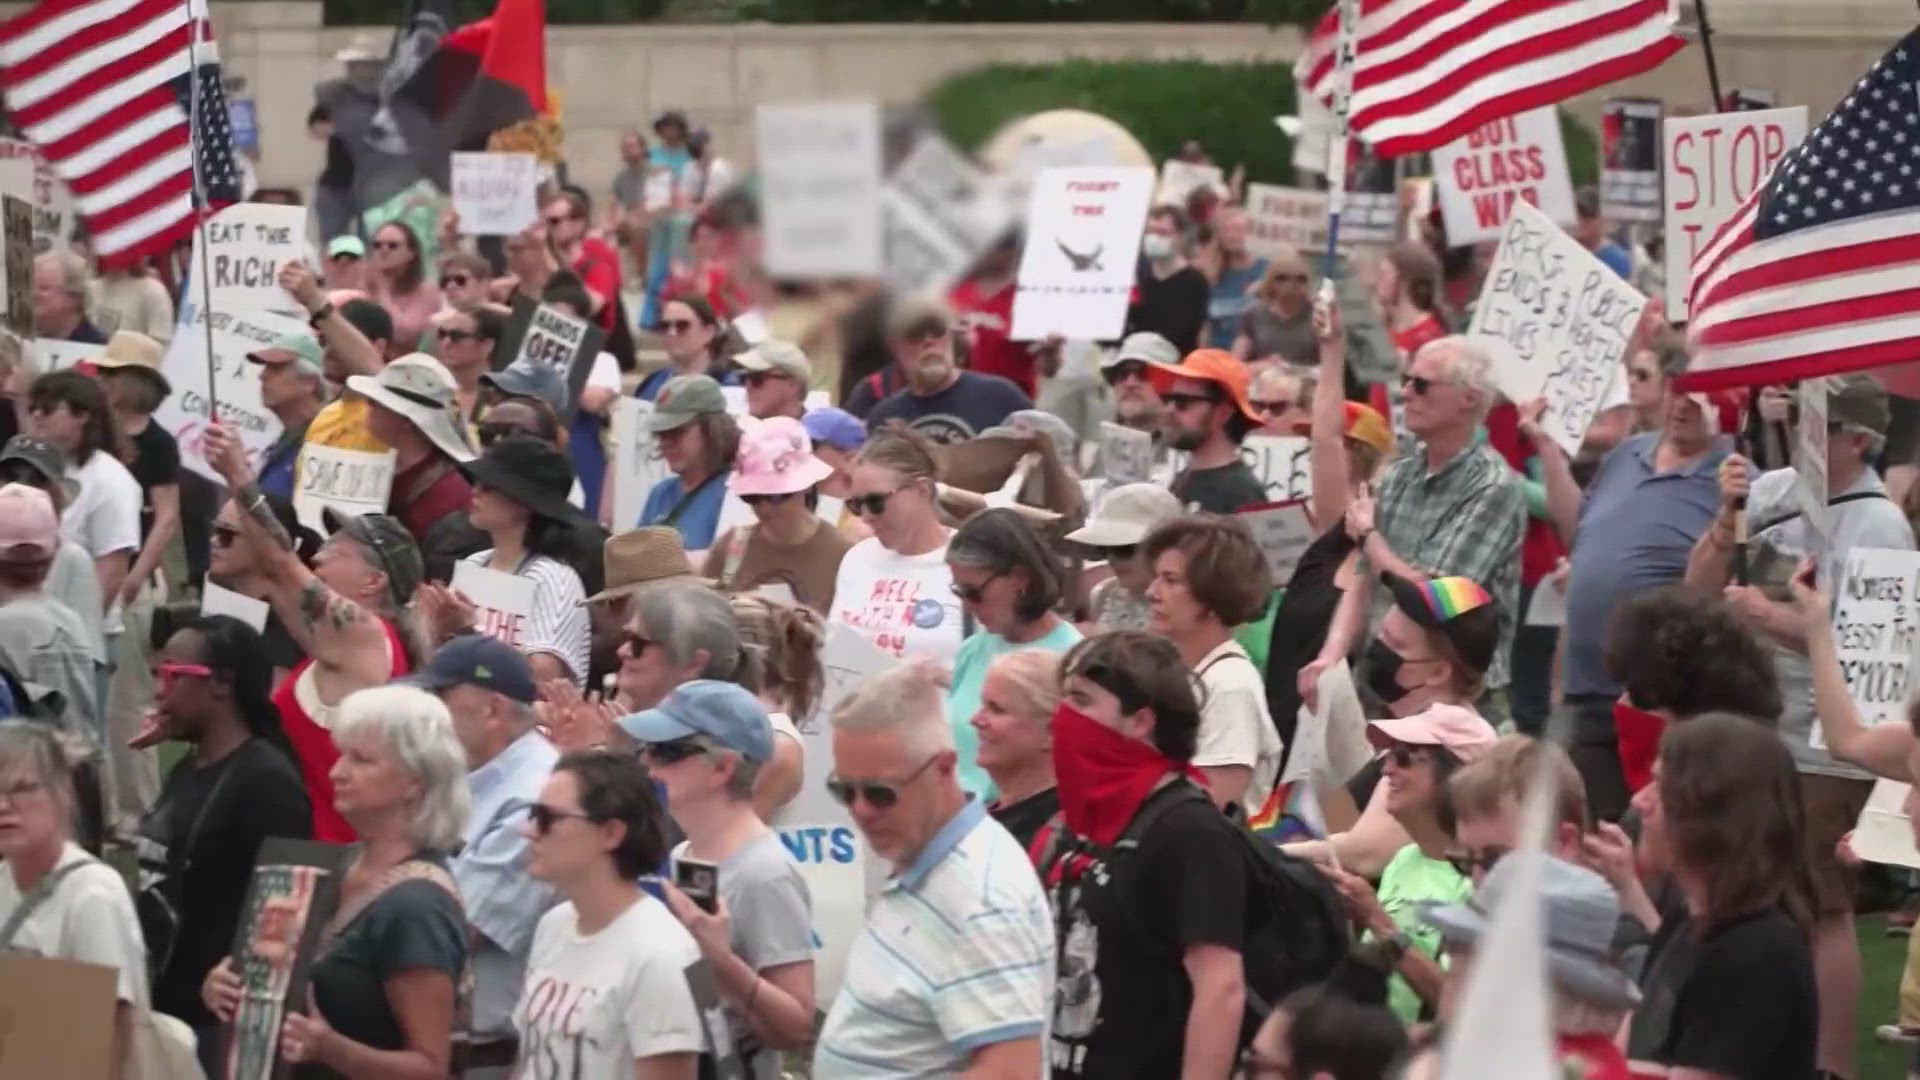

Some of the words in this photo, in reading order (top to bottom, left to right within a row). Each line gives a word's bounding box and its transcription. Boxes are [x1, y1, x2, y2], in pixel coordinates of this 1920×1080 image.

[1453, 145, 1546, 191] CLASS
[1672, 124, 1786, 211] STOP
[209, 222, 246, 244] EAT
[254, 224, 292, 244] THE
[214, 254, 276, 289] RICH
[485, 606, 526, 647] THE
